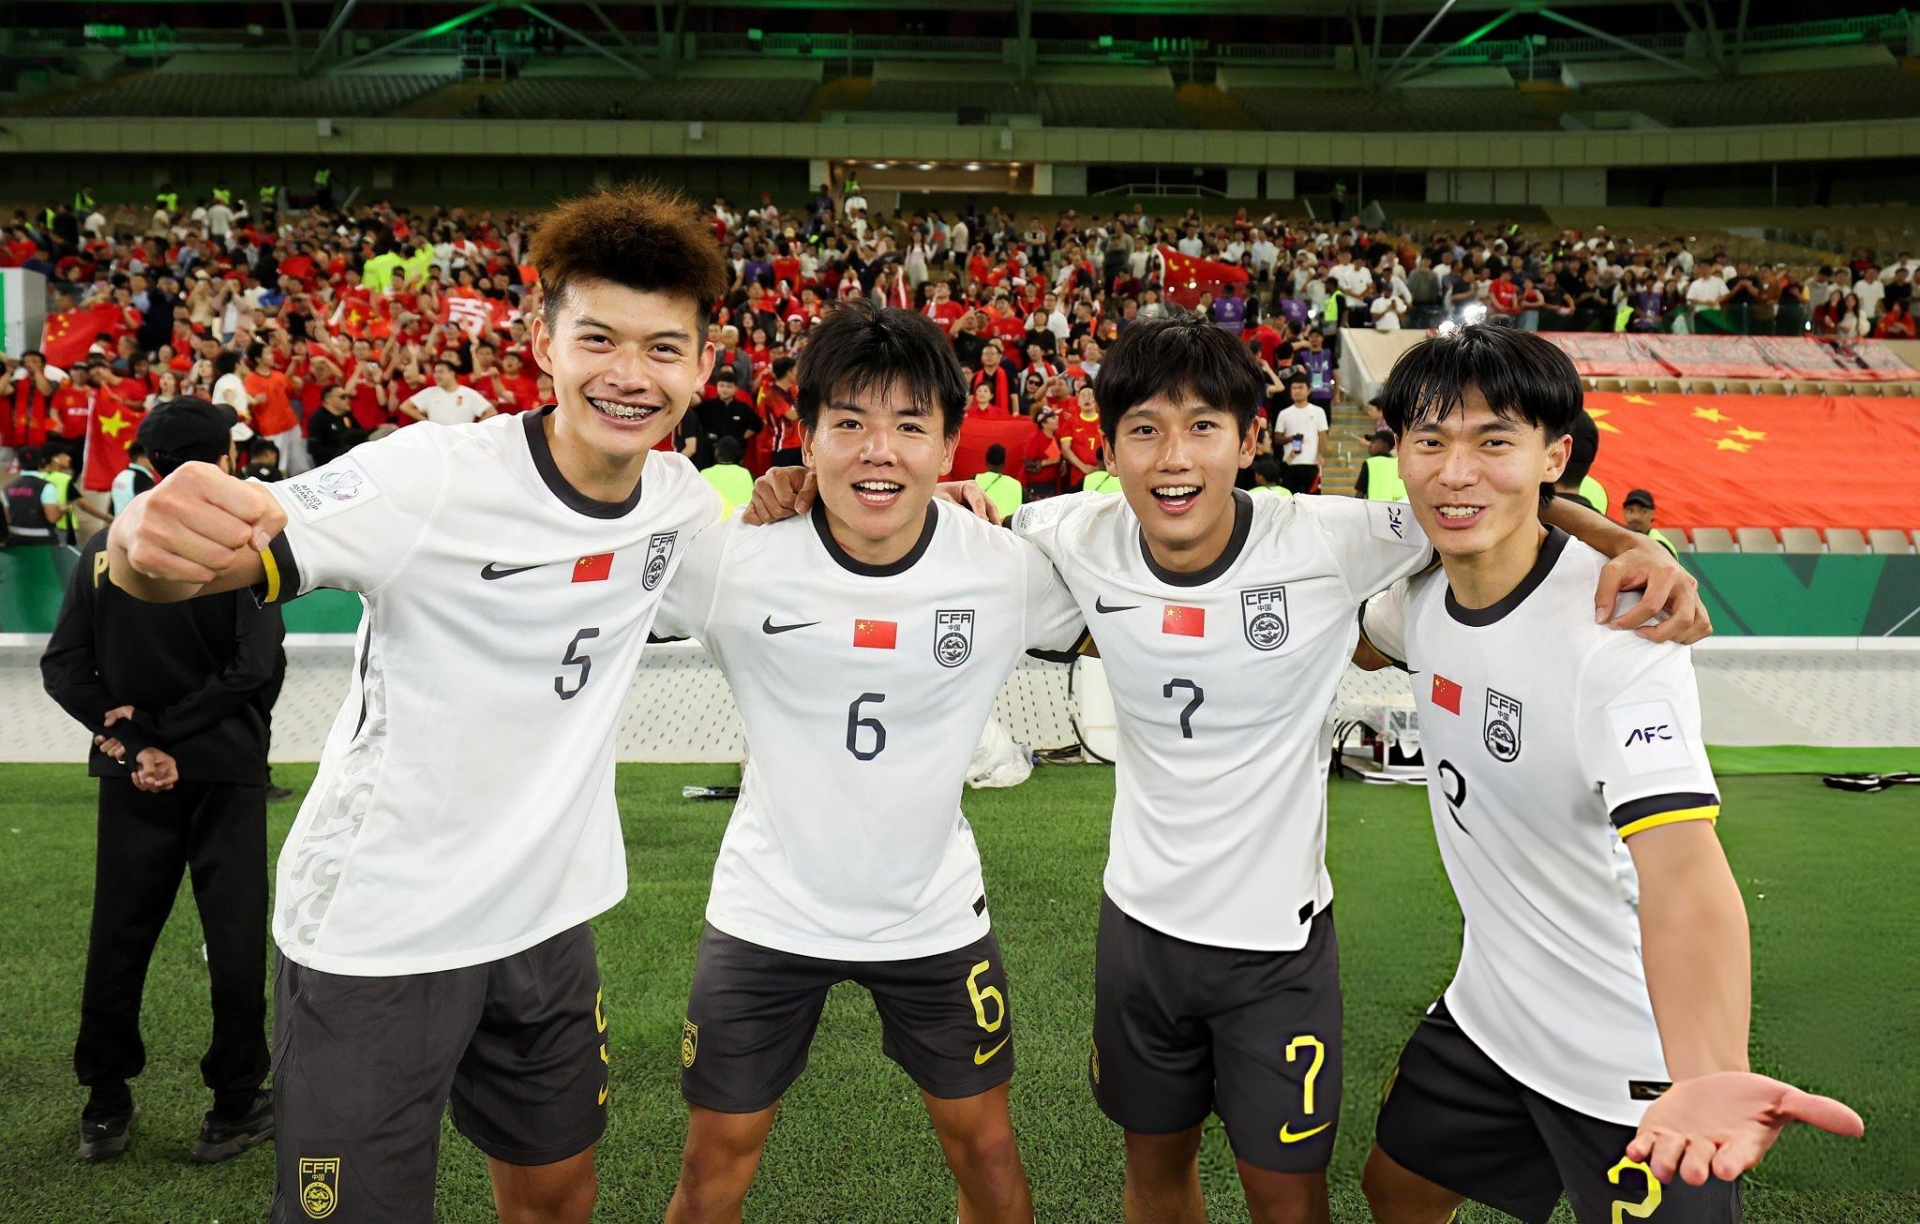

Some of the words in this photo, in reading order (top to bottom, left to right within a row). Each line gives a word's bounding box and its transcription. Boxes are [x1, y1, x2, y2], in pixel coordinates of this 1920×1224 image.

[292, 483, 308, 499] ASIAN
[306, 498, 318, 509] CUP
[1387, 506, 1402, 539] AFC
[652, 535, 675, 548] CFA
[1246, 590, 1282, 605] CFA
[939, 613, 971, 624] CFA
[555, 628, 600, 700] 5
[1164, 678, 1204, 739] 7
[1490, 694, 1519, 717] CFA
[846, 693, 887, 761] 6
[1625, 725, 1673, 747] AFC
[966, 960, 1005, 1033] 6
[1285, 1036, 1325, 1115] 7
[303, 1162, 335, 1174] CFA
